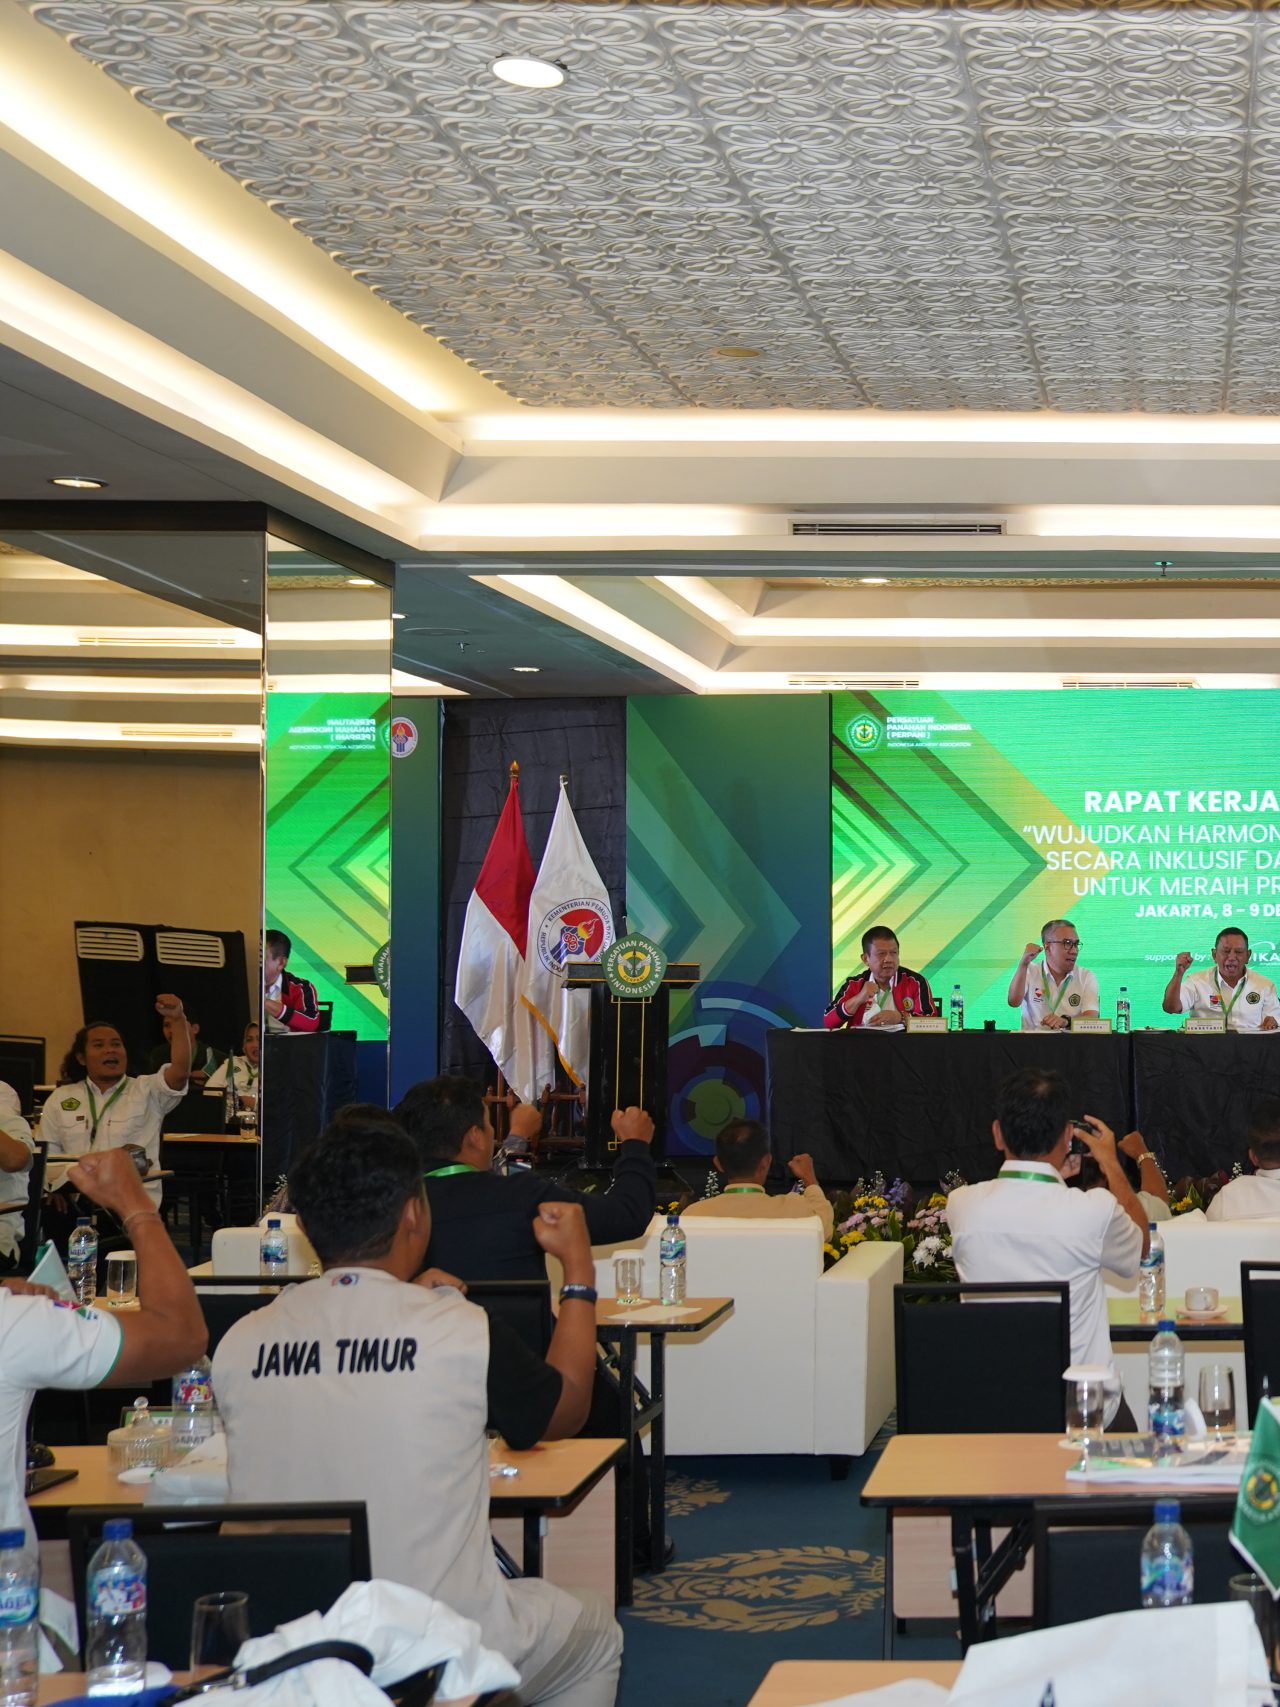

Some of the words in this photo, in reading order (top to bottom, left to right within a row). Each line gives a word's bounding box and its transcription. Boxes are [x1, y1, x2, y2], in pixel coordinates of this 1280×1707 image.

[1084, 790, 1181, 813] RAPAT
[1187, 789, 1280, 813] KERJA
[1046, 850, 1141, 871] SECARA
[1149, 850, 1249, 870] INKLUSIF
[1073, 876, 1152, 897] UNTUK
[1160, 876, 1249, 896] MERAIH
[548, 901, 590, 922] KEMENTERIAN
[591, 901, 611, 925] PEMUDA
[1135, 903, 1218, 920] JAKARTA,
[1222, 904, 1233, 917] 8
[1249, 903, 1260, 917] 9
[607, 940, 638, 972] PERSATUAN
[639, 941, 662, 972] PANAHAN
[611, 977, 657, 994] INDONESIA
[251, 1340, 321, 1379] JAWA
[335, 1336, 418, 1375] TIMUR
